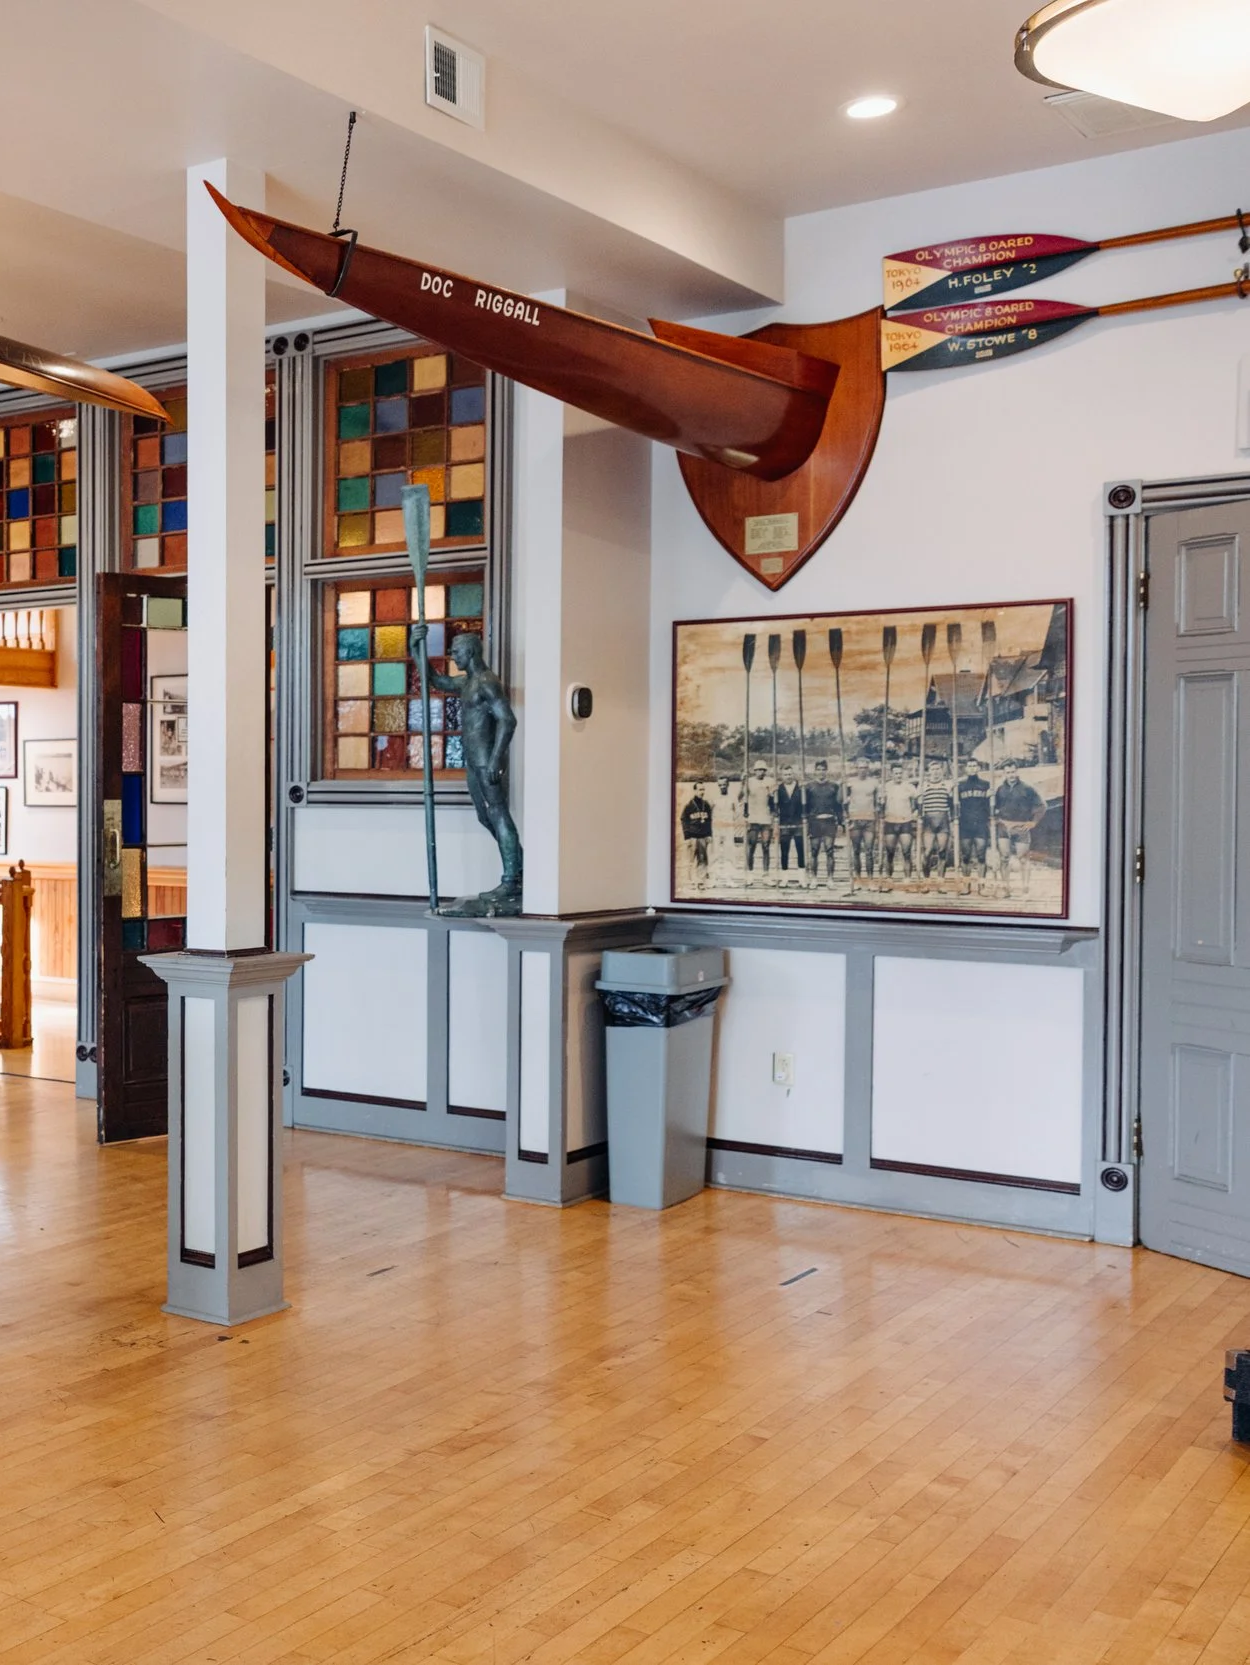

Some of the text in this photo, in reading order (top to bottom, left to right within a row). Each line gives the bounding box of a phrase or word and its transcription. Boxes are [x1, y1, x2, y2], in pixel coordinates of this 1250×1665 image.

[916, 237, 1034, 261] OLYMPIC 8 OARED
[943, 250, 1016, 268] CHAMPION
[886, 267, 921, 278] TOKYO
[420, 272, 453, 298] DOC
[475, 289, 540, 326] RIGGALL
[923, 301, 1035, 323] OLYMPIC 8 OARED
[945, 316, 1017, 334] CHAMPION
[886, 331, 921, 342] TOKYO
